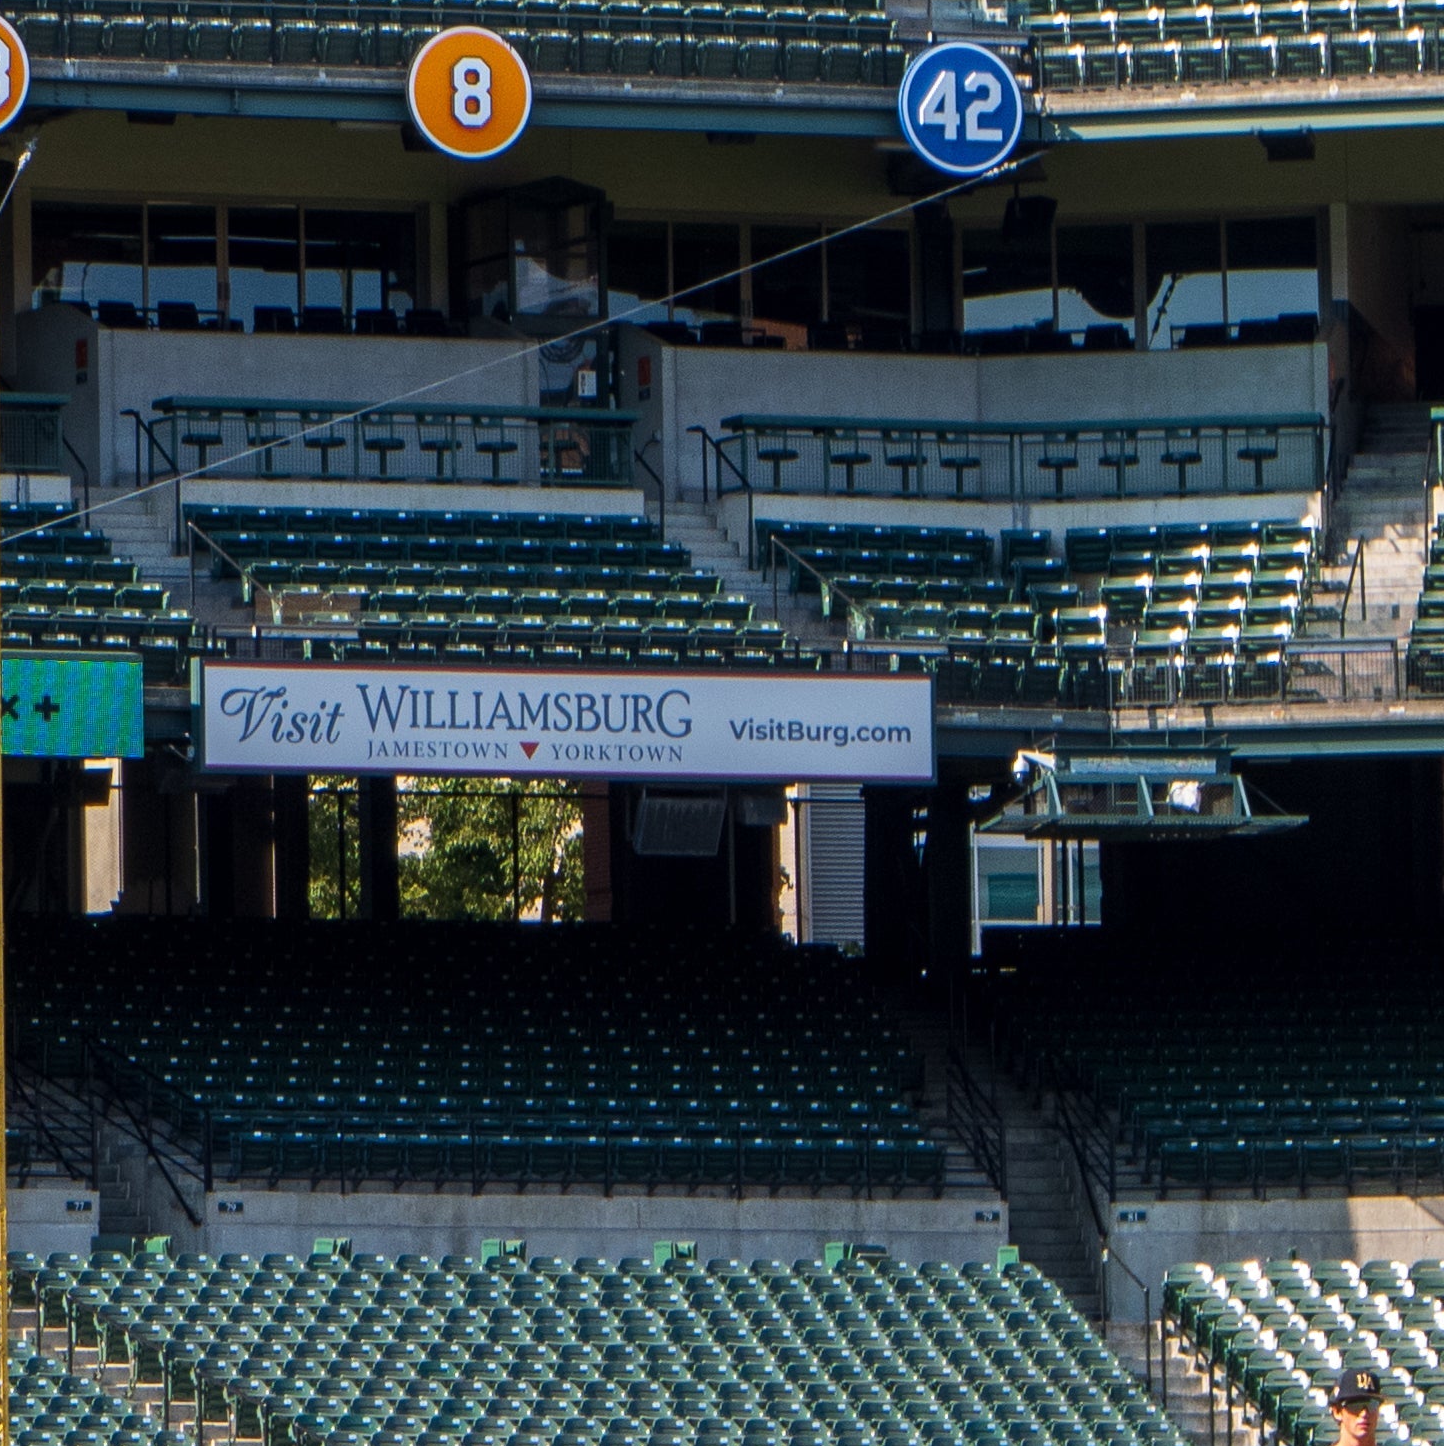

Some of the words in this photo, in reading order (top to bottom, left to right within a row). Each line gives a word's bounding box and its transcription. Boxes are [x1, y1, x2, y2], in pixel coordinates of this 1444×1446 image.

[450, 56, 492, 127] 8
[918, 70, 1003, 142] 42
[219, 685, 346, 745] Visit
[356, 683, 693, 739] WILLIAMSBURG
[728, 717, 913, 748] VisitBurg.com
[367, 739, 510, 761] JAMESTOWN
[549, 742, 686, 763] YORKTOWN
